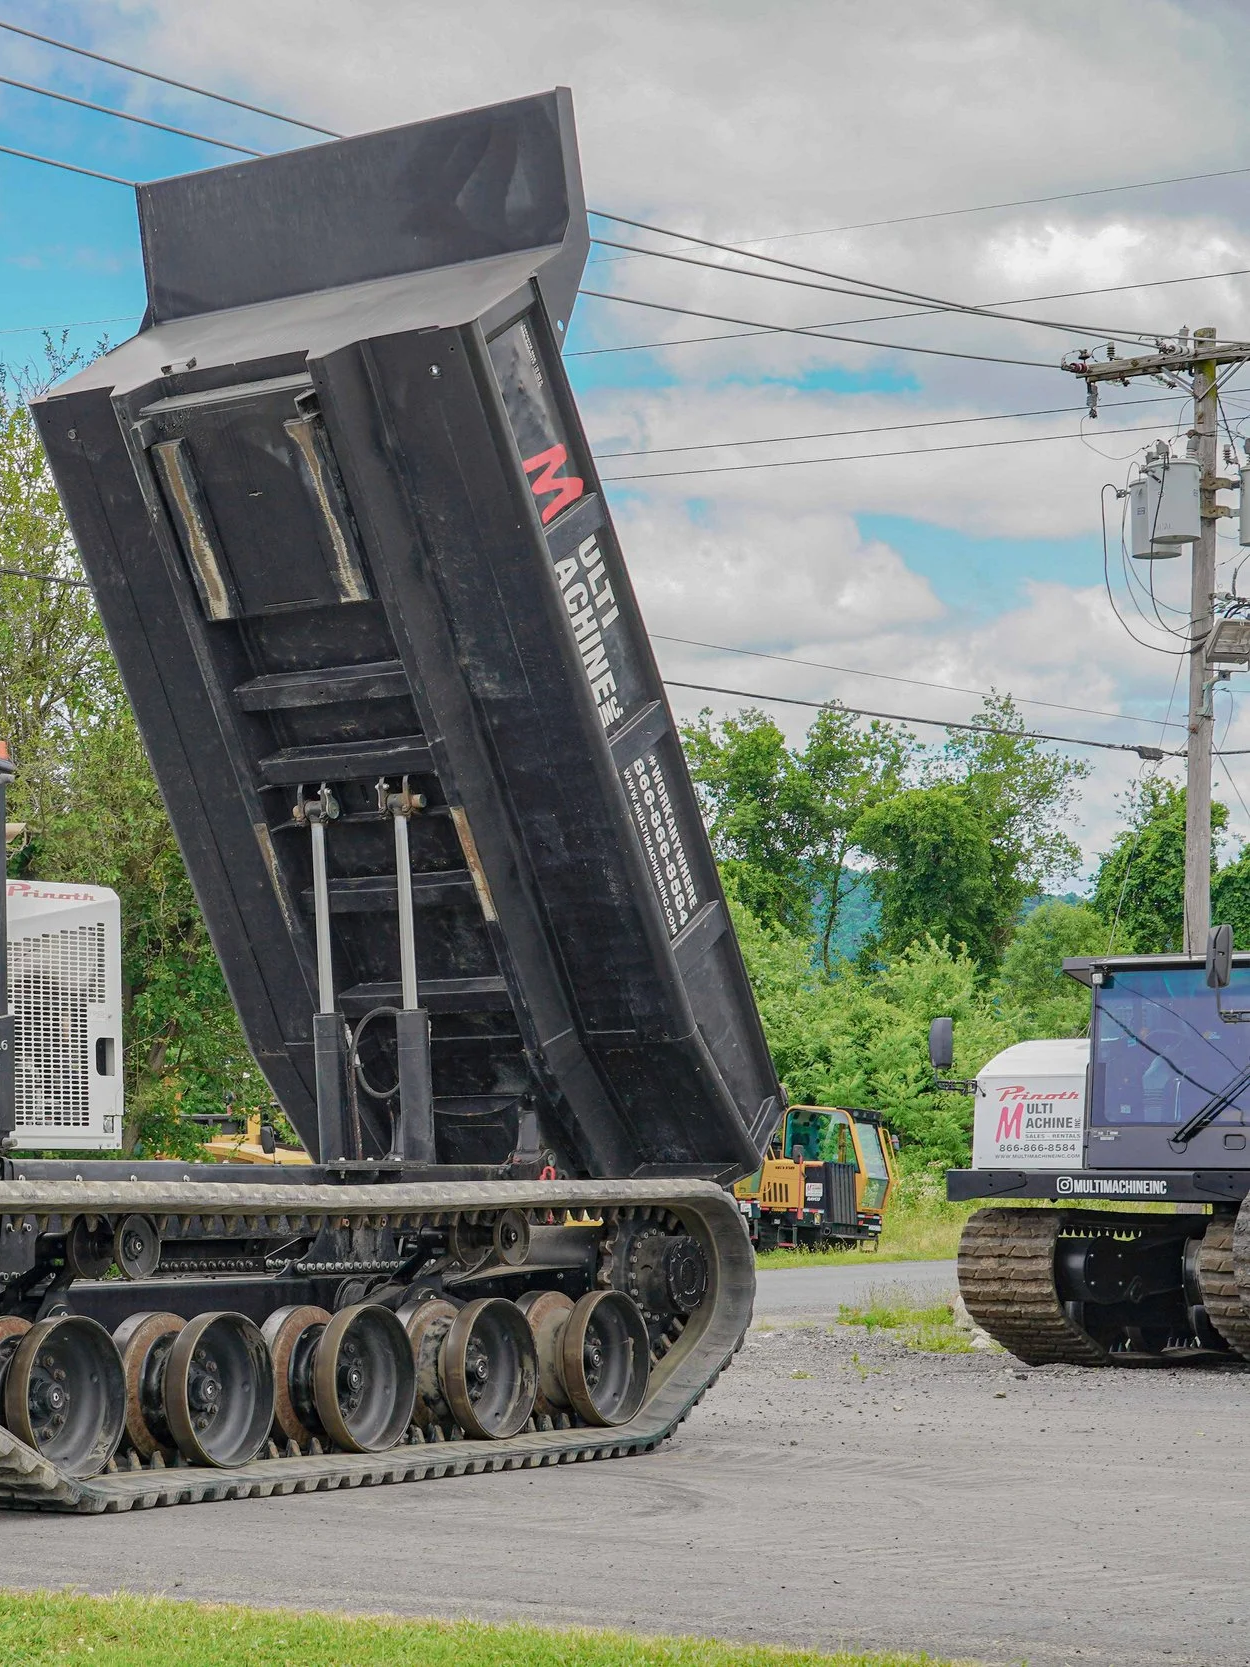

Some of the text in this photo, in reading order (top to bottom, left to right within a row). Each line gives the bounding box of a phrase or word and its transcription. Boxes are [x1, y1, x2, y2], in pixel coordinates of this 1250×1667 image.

[522, 443, 584, 524] M
[578, 533, 620, 629] ULTI
[554, 556, 617, 704] ACHINE
[623, 767, 678, 936] WWW.MULTIMACHINEINC.COM
[633, 758, 689, 926] 866-866-8584
[648, 754, 698, 909] #WORKANYWHERE
[995, 1085, 1079, 1102] Prinoth
[995, 1102, 1024, 1143] M
[1025, 1117, 1073, 1129] ACHINE
[1026, 1103, 1053, 1114] ULTI
[999, 1143, 1076, 1152] 866-866-8584
[1073, 1179, 1168, 1195] MULTIMACHINEINC
